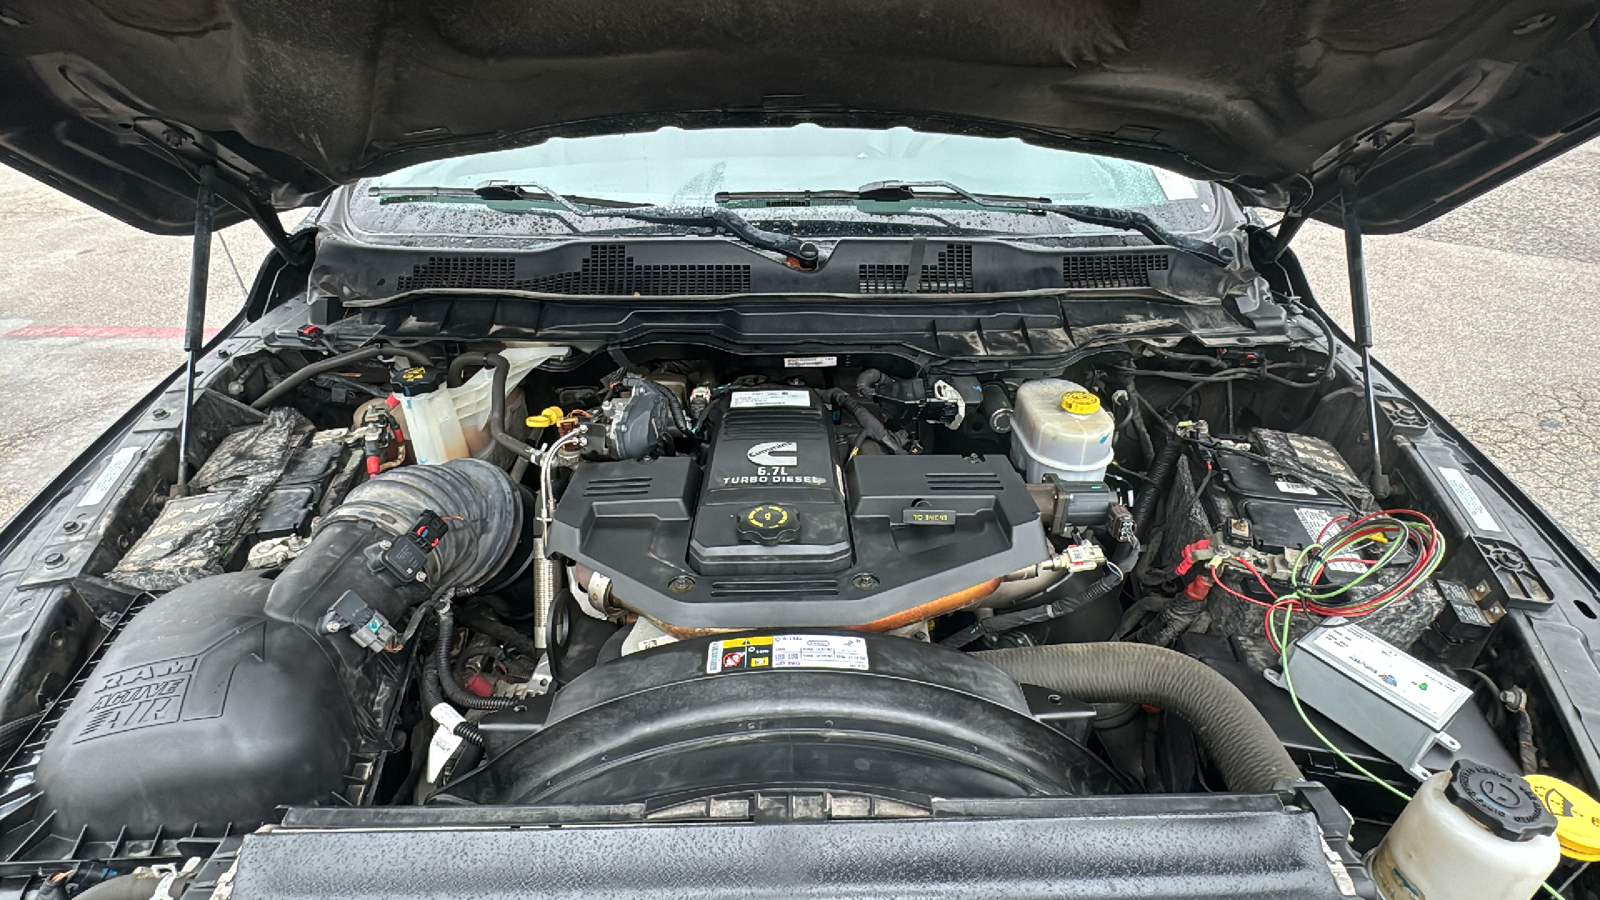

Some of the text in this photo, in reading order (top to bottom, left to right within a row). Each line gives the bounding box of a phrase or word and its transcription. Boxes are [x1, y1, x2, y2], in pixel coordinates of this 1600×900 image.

[723, 476, 819, 484] TURBO DIESEL
[757, 466, 788, 476] 6.7L
[94, 656, 198, 694] RAM
[87, 677, 186, 713] ACTIVE
